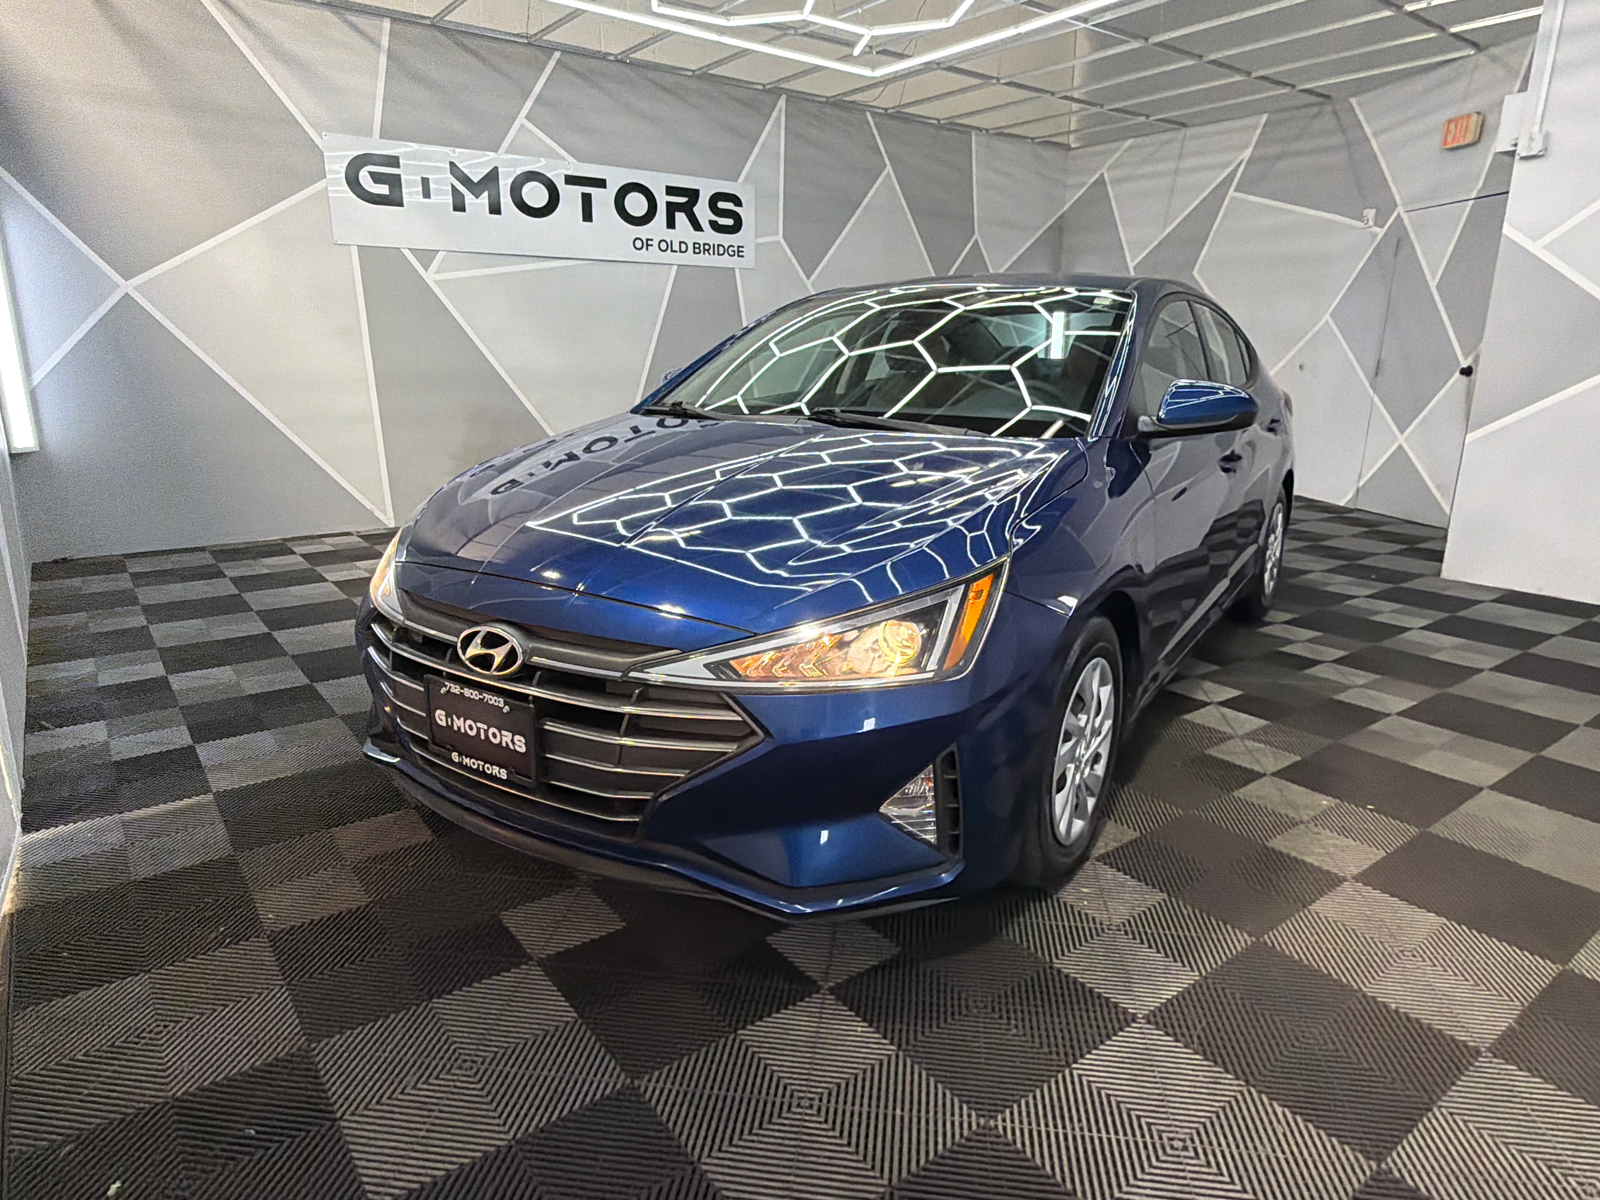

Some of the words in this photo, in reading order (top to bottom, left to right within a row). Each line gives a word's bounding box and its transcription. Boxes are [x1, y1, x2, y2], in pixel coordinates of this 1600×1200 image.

[632, 236, 654, 251] OF
[657, 239, 689, 254] OLD
[692, 241, 745, 258] BRIDGE
[444, 681, 505, 708] 732-800-7003
